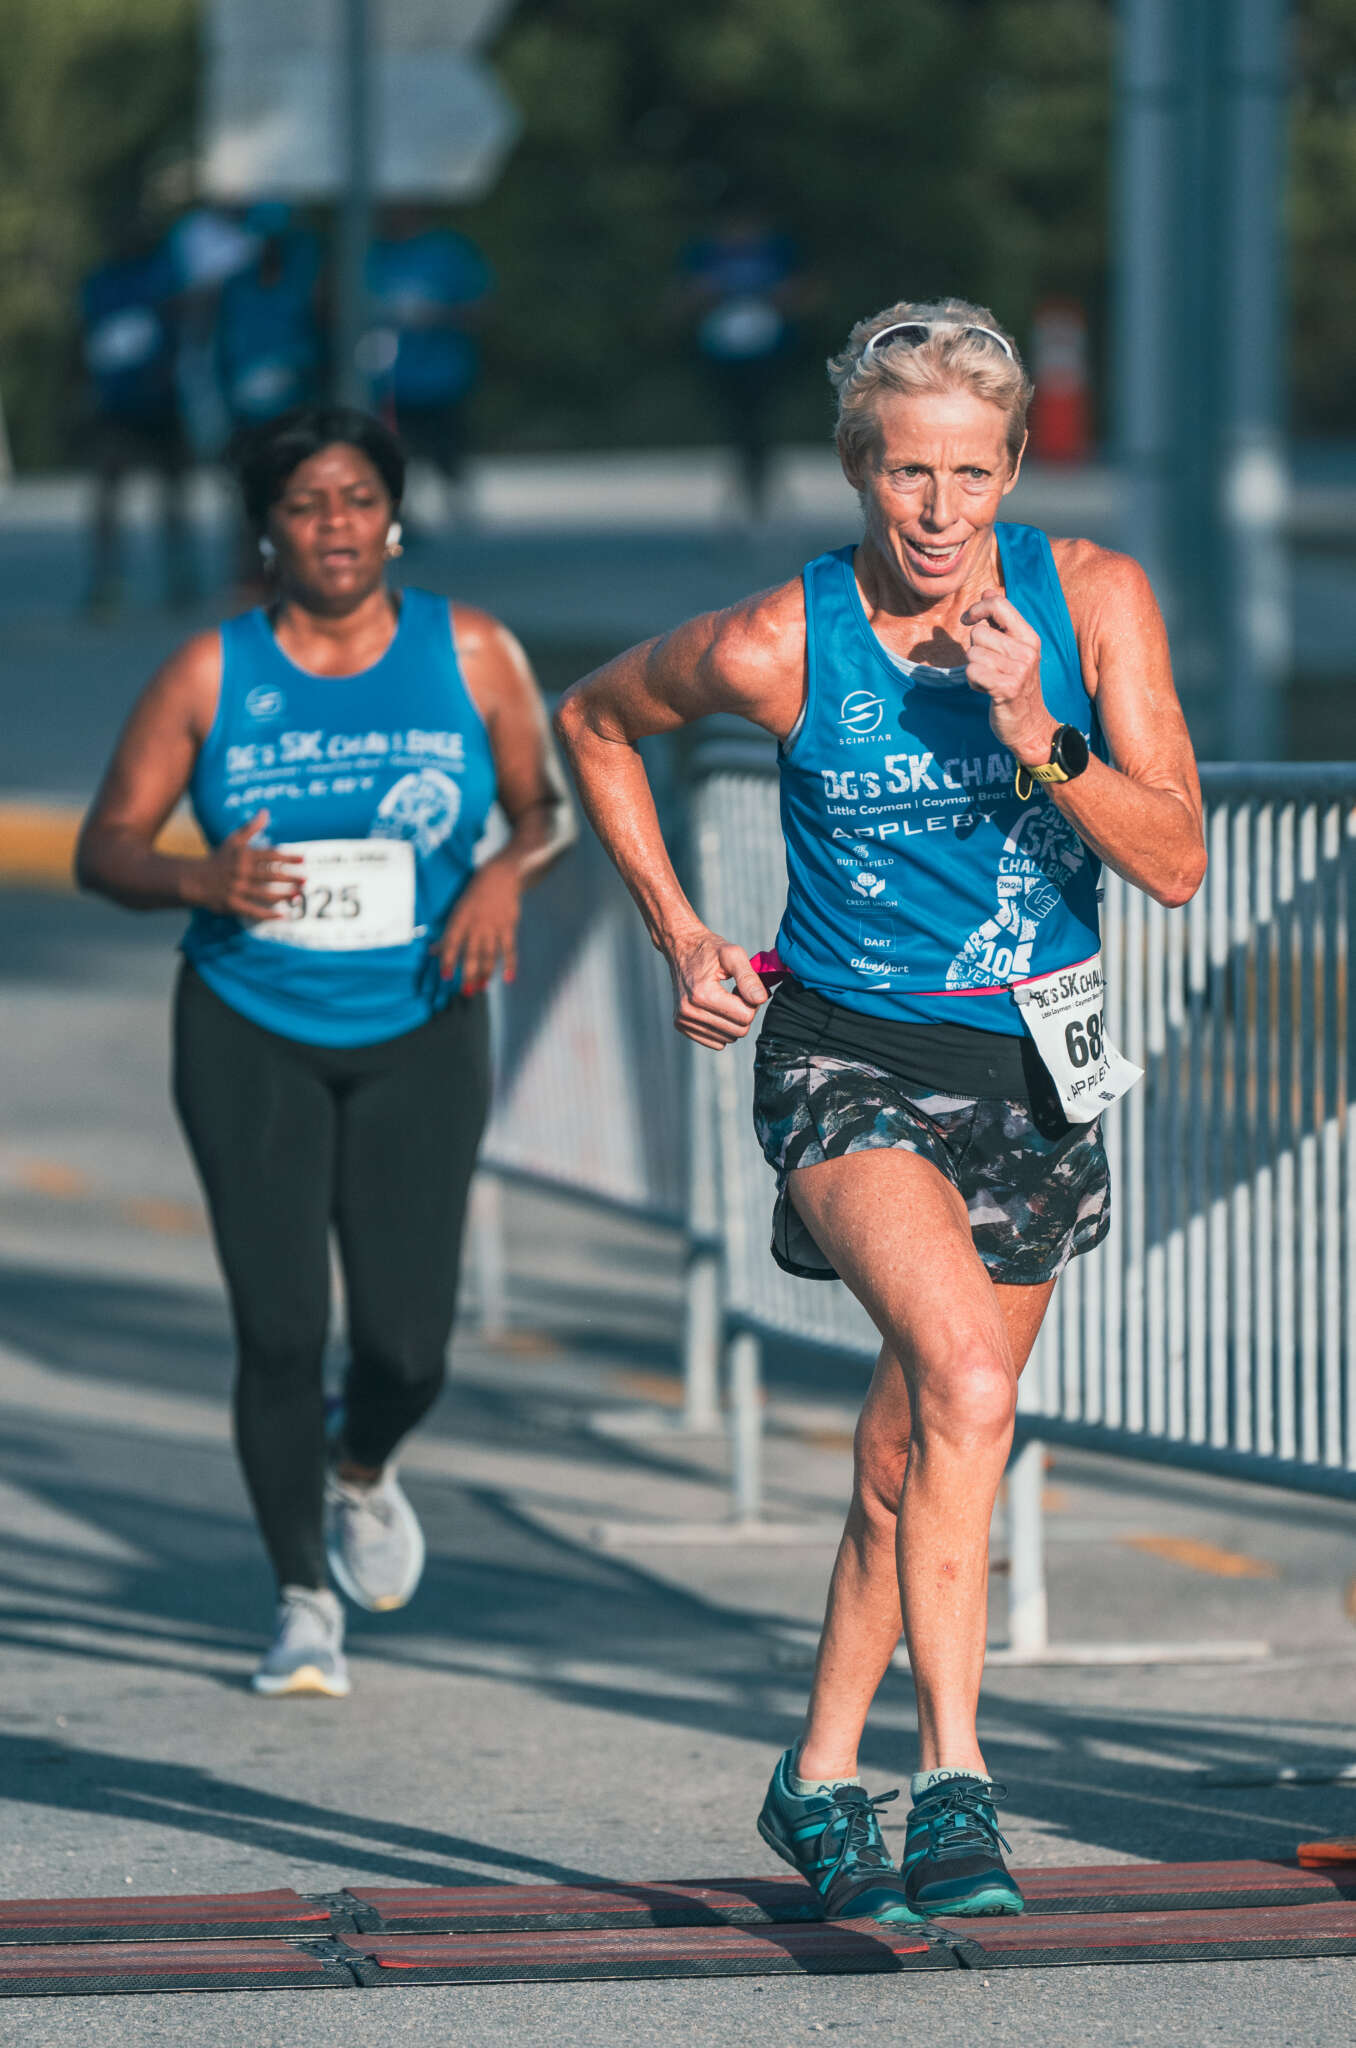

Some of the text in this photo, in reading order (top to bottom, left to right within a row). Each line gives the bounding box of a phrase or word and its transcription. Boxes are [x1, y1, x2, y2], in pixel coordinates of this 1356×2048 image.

[839, 734, 892, 745] SCIMITAR
[884, 752, 939, 793] 5K
[943, 753, 1015, 790] CHAL
[827, 790, 1007, 816] Little Cayman Cayman Brac
[832, 809, 997, 841] APPLEBY
[1018, 820, 1068, 861] 5K
[836, 858, 894, 868] BUTTERFIELD
[998, 881, 1022, 890] 2024
[846, 899, 871, 907] CREDIT
[863, 937, 892, 948] DART
[850, 956, 910, 976] Davenport
[974, 940, 1014, 979] 10
[1058, 972, 1080, 999] 5K
